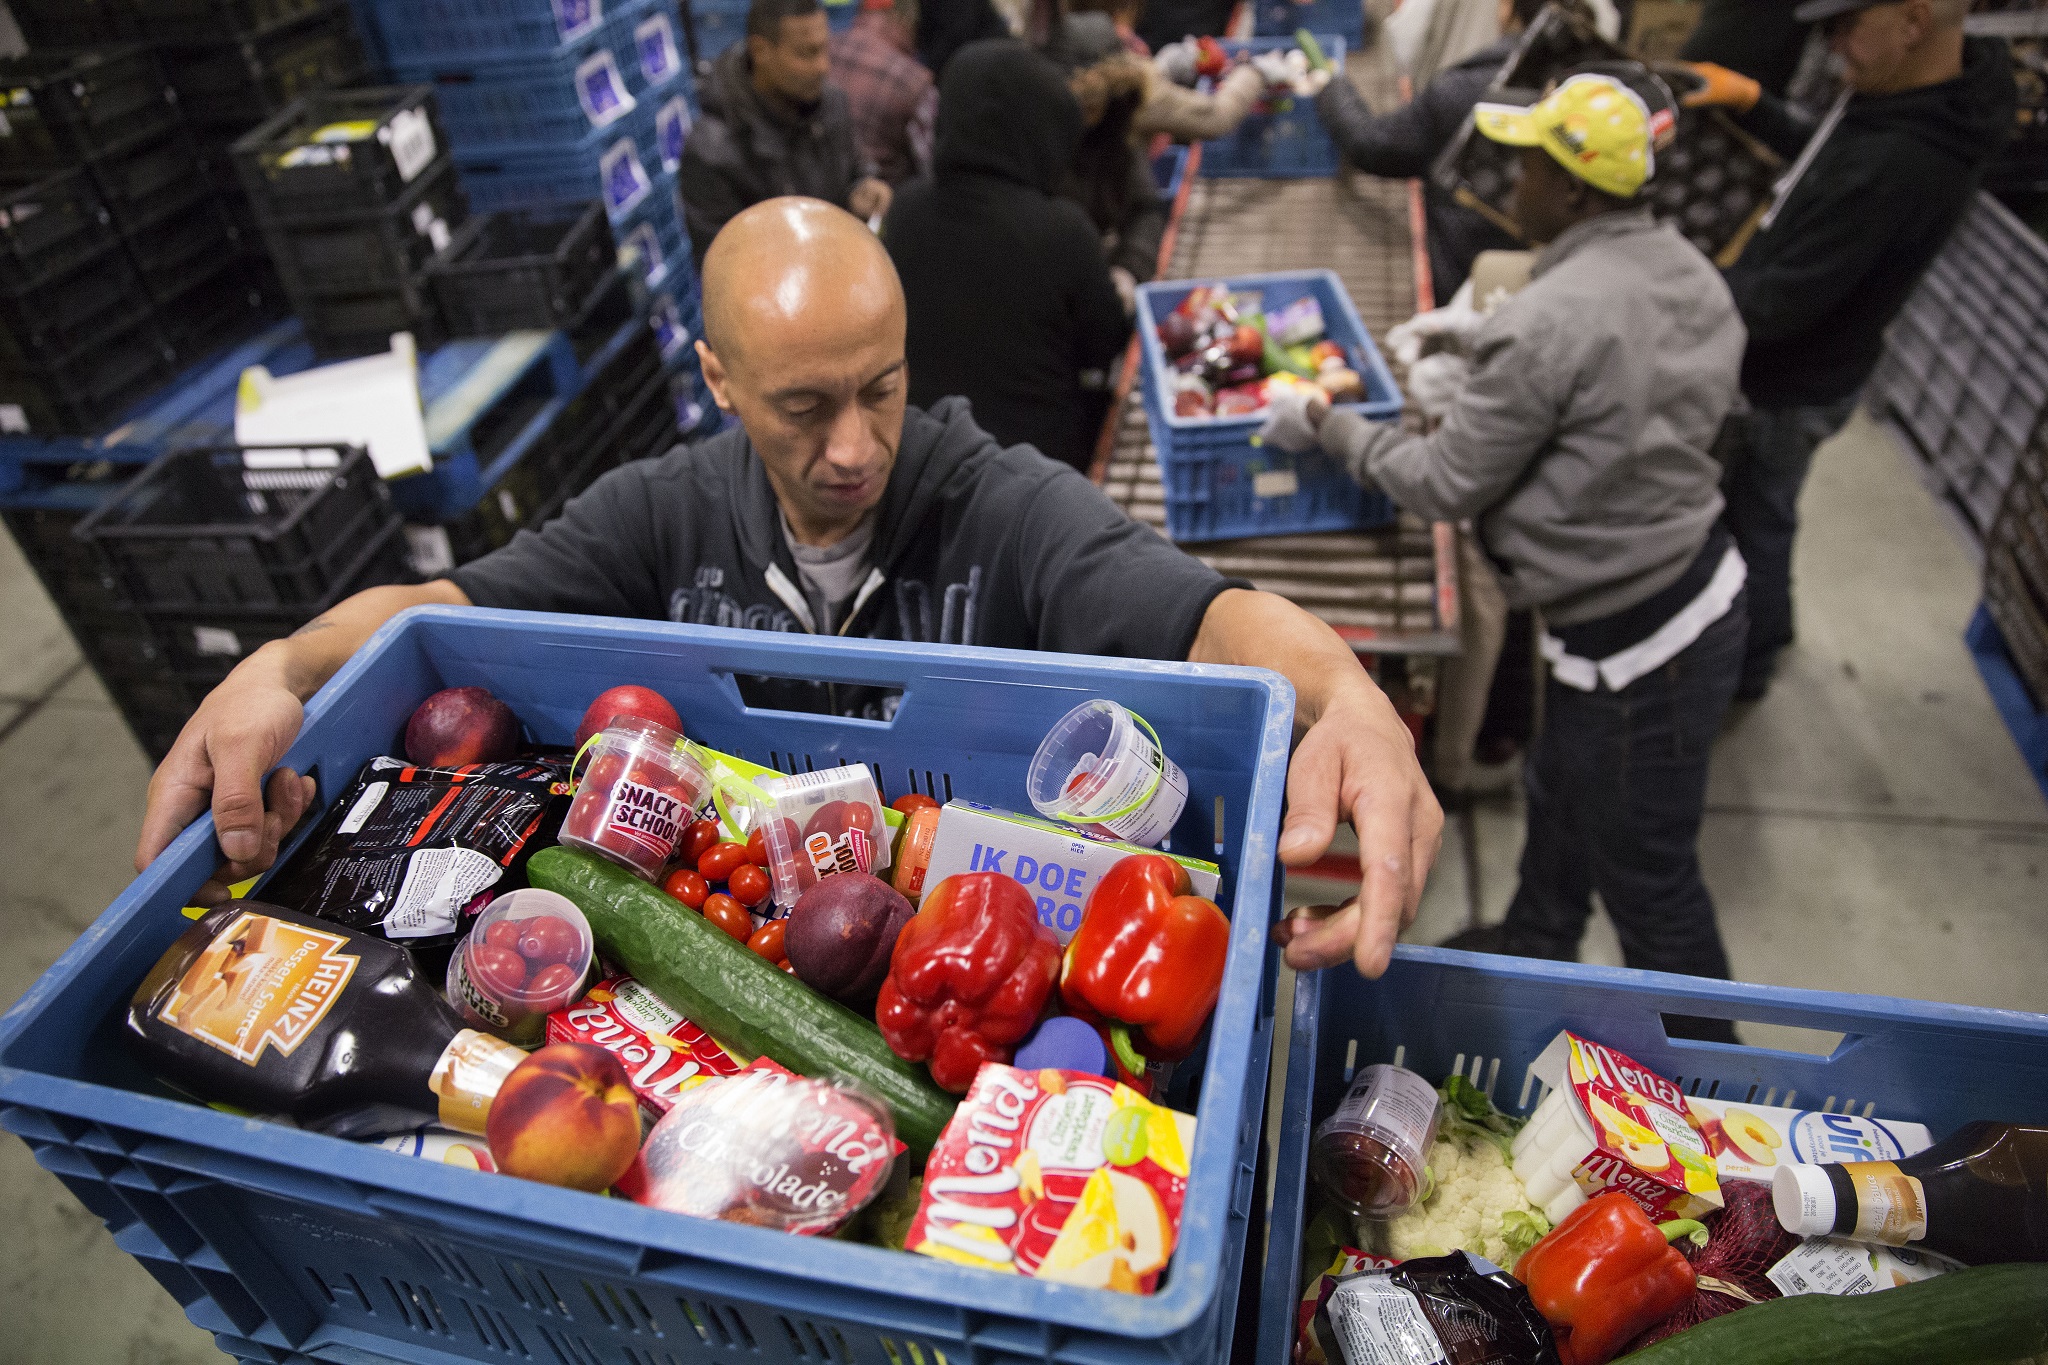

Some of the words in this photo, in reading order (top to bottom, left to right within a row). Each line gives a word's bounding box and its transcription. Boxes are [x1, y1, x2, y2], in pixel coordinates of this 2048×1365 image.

[617, 782, 677, 820] SNACK
[617, 804, 679, 843] SCHOOL
[809, 835, 828, 863] TO
[970, 844, 1008, 873] IK
[1014, 856, 1086, 898] DOE
[239, 957, 275, 1001] moka-caramel
[245, 957, 283, 1005] mokka-karamel
[267, 940, 319, 990] Dessert
[235, 991, 273, 1038] Sauce
[275, 961, 342, 1036] HEINZ
[623, 992, 656, 1022] Citroen
[624, 983, 675, 1025] kwarktaart
[567, 1003, 726, 1102] Mona
[1575, 1040, 1683, 1112] Mona
[1804, 1121, 1820, 1165] afweersystee
[1817, 1134, 1826, 1149] voor
[1819, 1148, 1827, 1157] je
[1871, 1128, 1885, 1156] belangrijke
[925, 1073, 1038, 1263] Mona
[1573, 1155, 1665, 1199] Mona
[1725, 1163, 1752, 1173] perzik
[1866, 1173, 1882, 1204] Sauce
[1870, 1206, 1883, 1236] essert
[1834, 1249, 1849, 1263] CLASS
[1837, 1255, 1854, 1271] WEIGHT
[1845, 1261, 1861, 1276] ORIGIN
[1825, 1277, 1842, 1293] HOLLAND
[1858, 1278, 1871, 1291] Red
